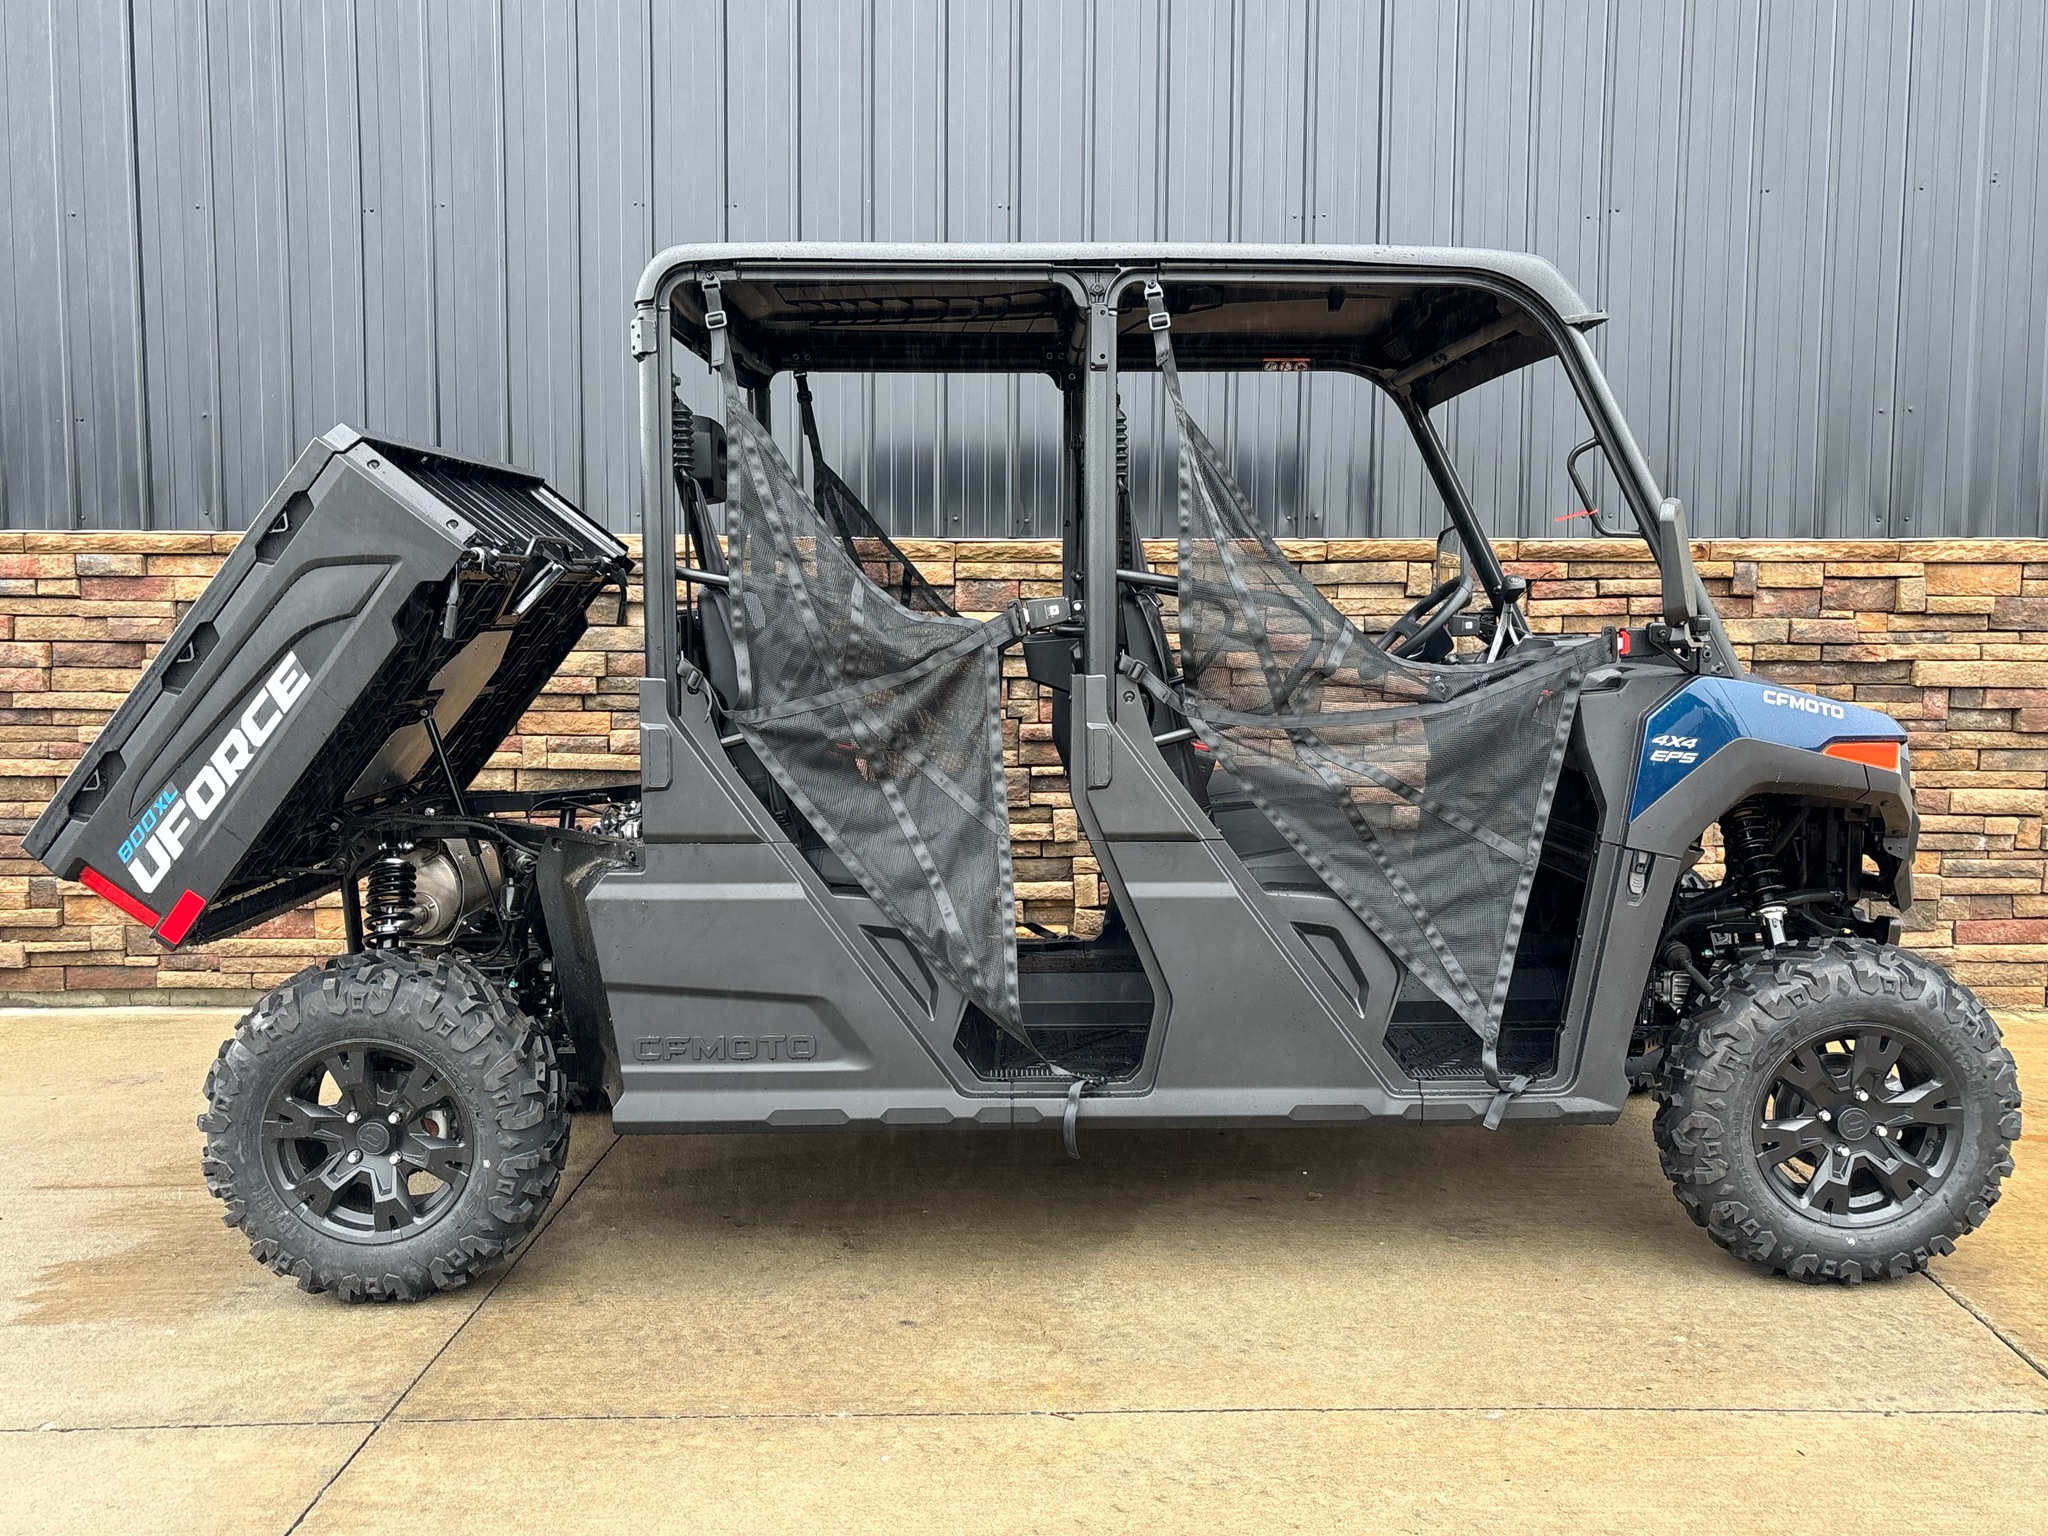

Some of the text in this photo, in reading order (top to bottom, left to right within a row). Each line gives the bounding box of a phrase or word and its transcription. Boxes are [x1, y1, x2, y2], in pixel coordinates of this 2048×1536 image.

[1762, 689, 1845, 719] CFMOTO
[1652, 735, 1699, 749] 4X4
[1650, 750, 1699, 764] EPS
[128, 651, 311, 894] UFORCE
[633, 1034, 817, 1061] CFMOTO
[1752, 1016, 1800, 1073] CST
